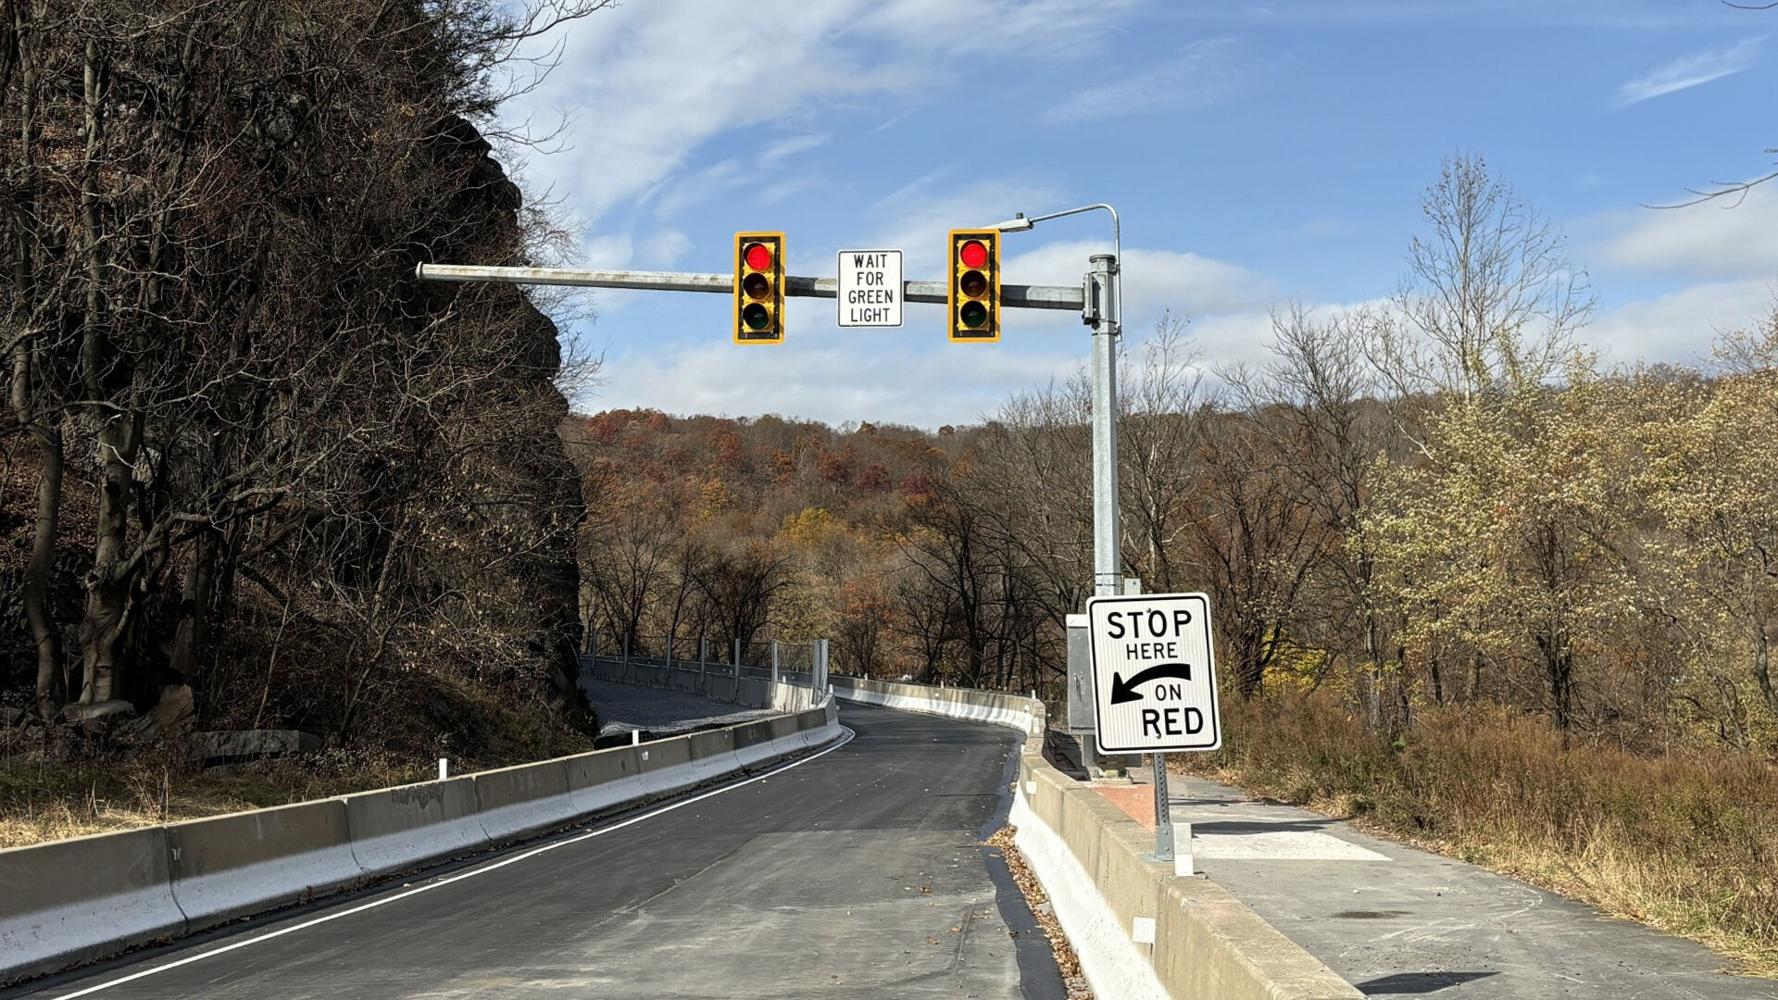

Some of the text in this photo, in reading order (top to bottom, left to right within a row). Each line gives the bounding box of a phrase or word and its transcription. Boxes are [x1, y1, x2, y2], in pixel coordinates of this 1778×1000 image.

[854, 254, 887, 268] WAIT
[857, 272, 884, 286] FOR
[848, 290, 893, 304] GREEN
[851, 308, 890, 322] LIGHT
[1107, 609, 1192, 639] STOP
[1126, 642, 1179, 660] HERE
[1155, 683, 1182, 701] ON
[1142, 707, 1204, 737] RED
